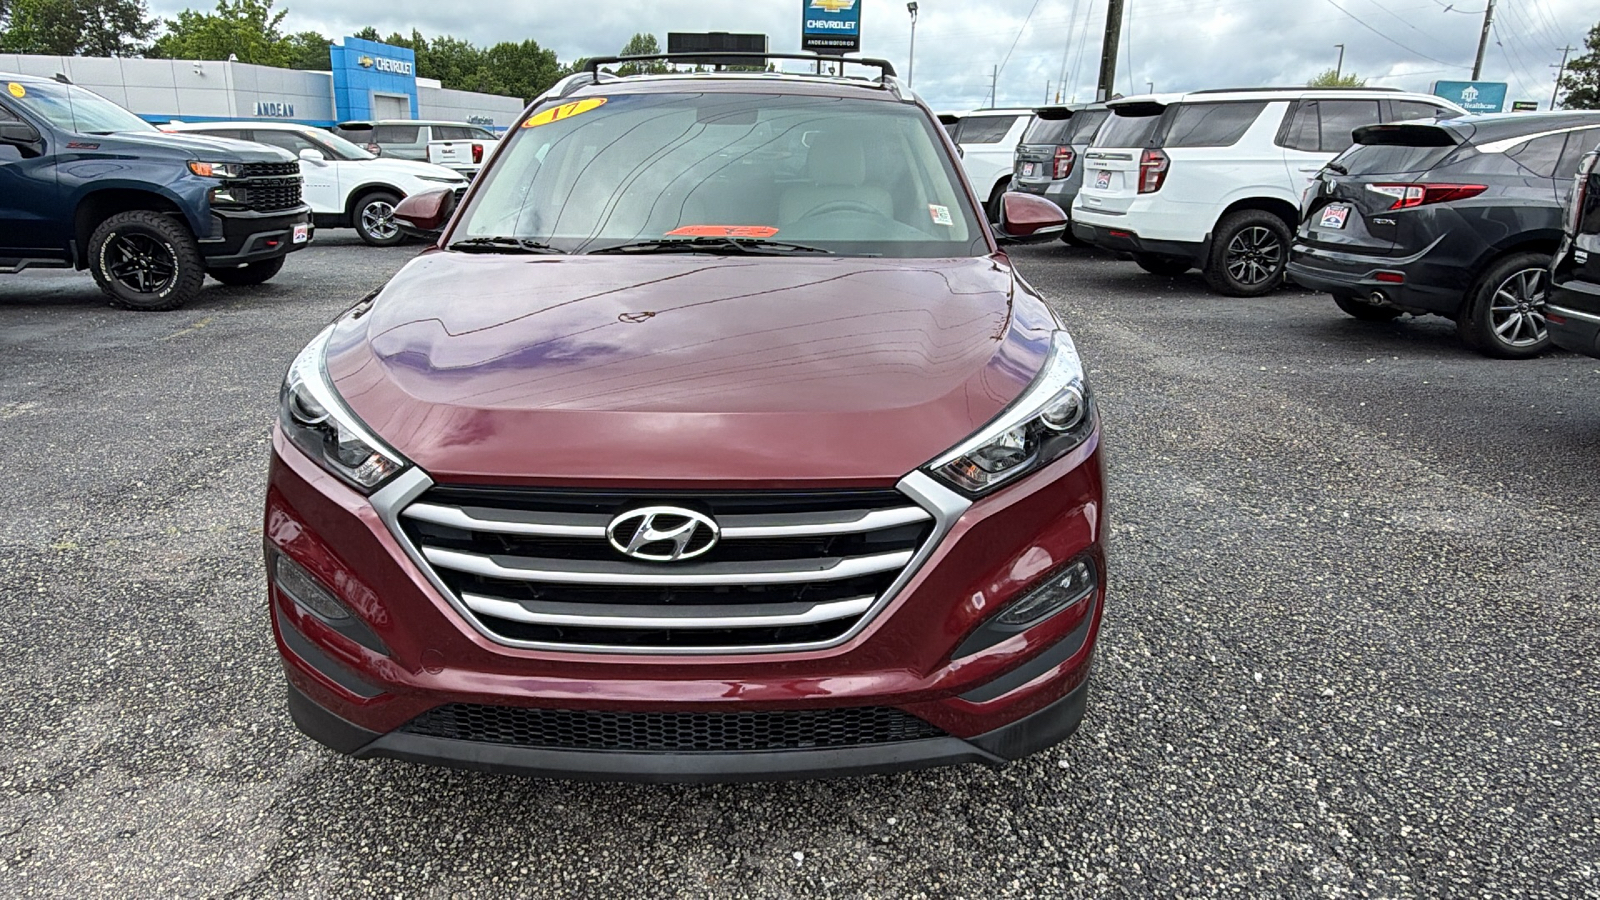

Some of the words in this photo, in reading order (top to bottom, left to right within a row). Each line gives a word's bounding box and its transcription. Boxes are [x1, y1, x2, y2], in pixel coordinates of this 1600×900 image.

[807, 20, 856, 29] CHEVROLET
[375, 57, 413, 75] CHEVROLET
[253, 102, 294, 117] ANDEAN
[551, 102, 580, 120] 17
[1464, 102, 1497, 110] Healthcare
[1373, 218, 1396, 226] RDX
